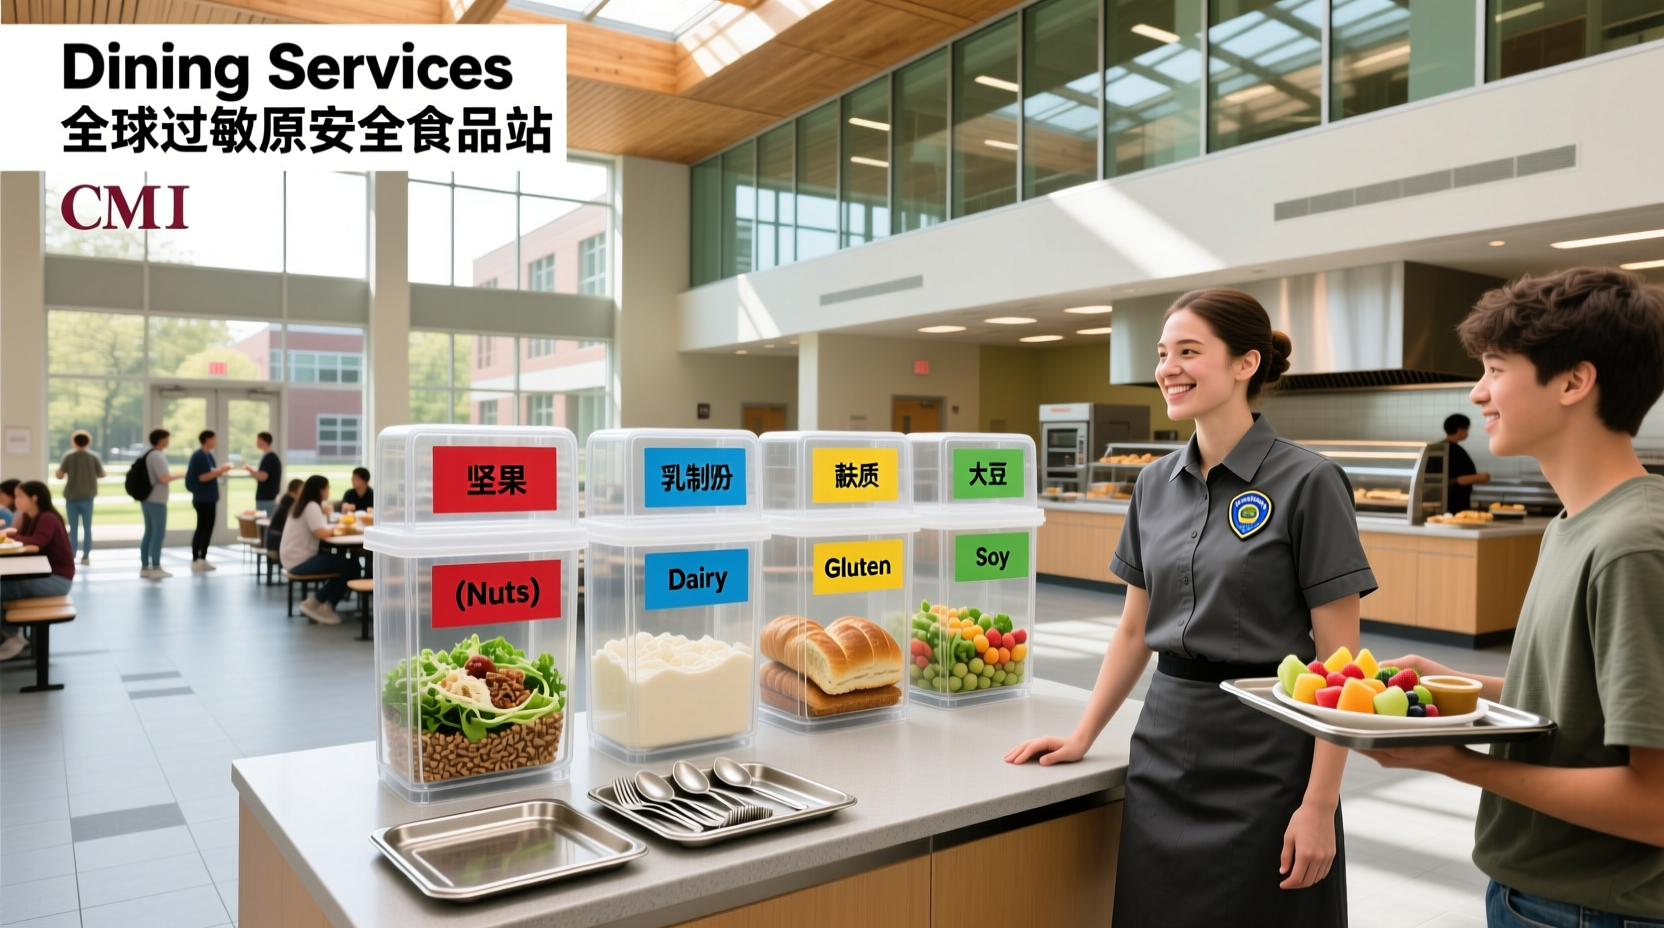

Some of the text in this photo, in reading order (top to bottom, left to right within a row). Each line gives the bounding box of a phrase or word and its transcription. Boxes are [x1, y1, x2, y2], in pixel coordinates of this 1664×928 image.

[467, 464, 527, 496] 坚果
[968, 461, 1008, 486] 大豆
[824, 556, 891, 578] Gluten
[976, 546, 1011, 571] Soy
[668, 566, 728, 594] Dairy
[455, 576, 540, 612] (Nuts)
